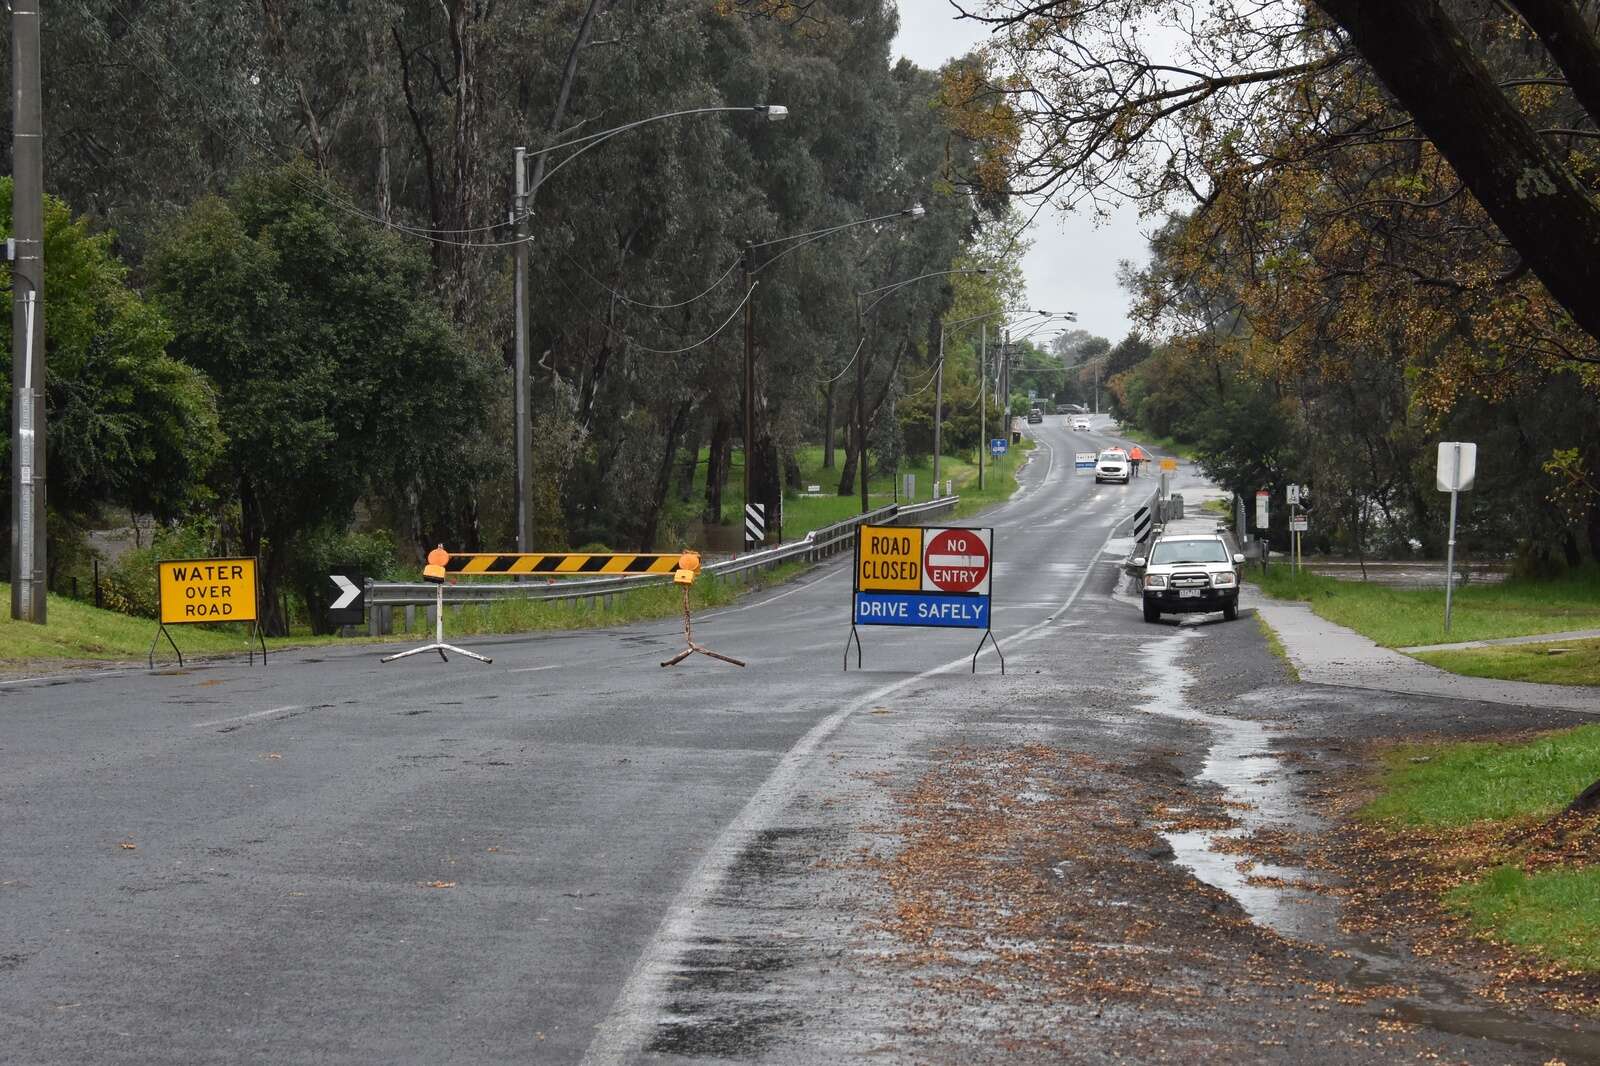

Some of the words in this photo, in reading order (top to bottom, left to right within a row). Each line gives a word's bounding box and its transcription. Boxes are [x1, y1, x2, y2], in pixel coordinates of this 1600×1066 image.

[871, 536, 911, 556] ROAD
[947, 539, 967, 552] NO
[173, 565, 243, 582] WATER
[862, 560, 918, 580] CLOSED
[933, 569, 978, 583] ENTRY
[185, 585, 232, 599] OVER
[185, 603, 233, 616] ROAD
[860, 601, 909, 617] DRIVE
[918, 603, 984, 620] SAFELY
